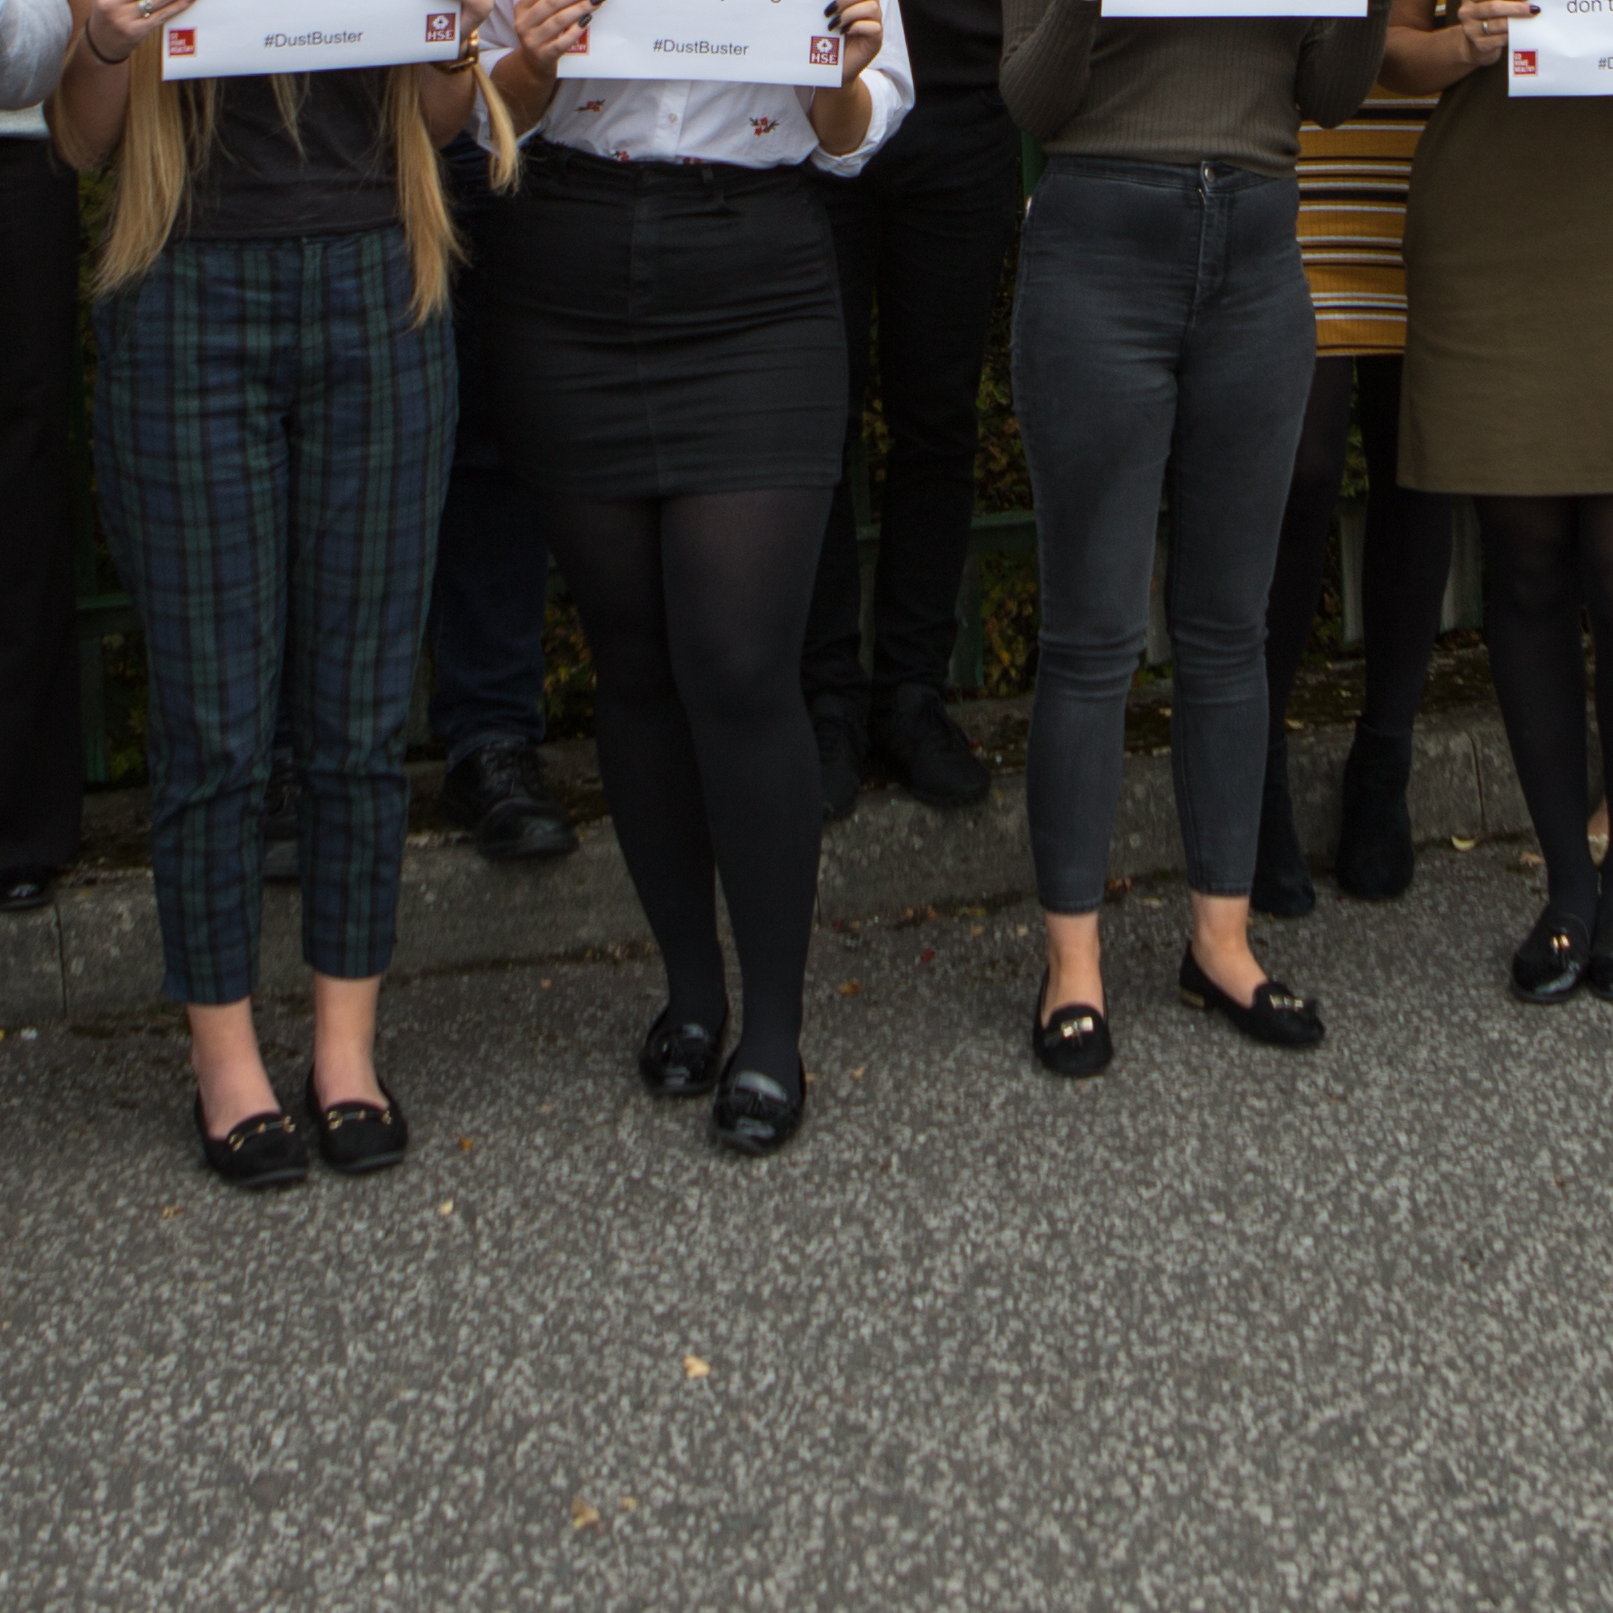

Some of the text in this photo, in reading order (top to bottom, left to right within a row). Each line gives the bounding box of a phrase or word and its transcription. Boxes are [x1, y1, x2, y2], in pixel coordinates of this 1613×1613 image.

[264, 31, 364, 48] #DustBuster
[427, 30, 453, 40] HSE
[653, 39, 749, 56] #DustBuster
[811, 53, 838, 64] HSE
